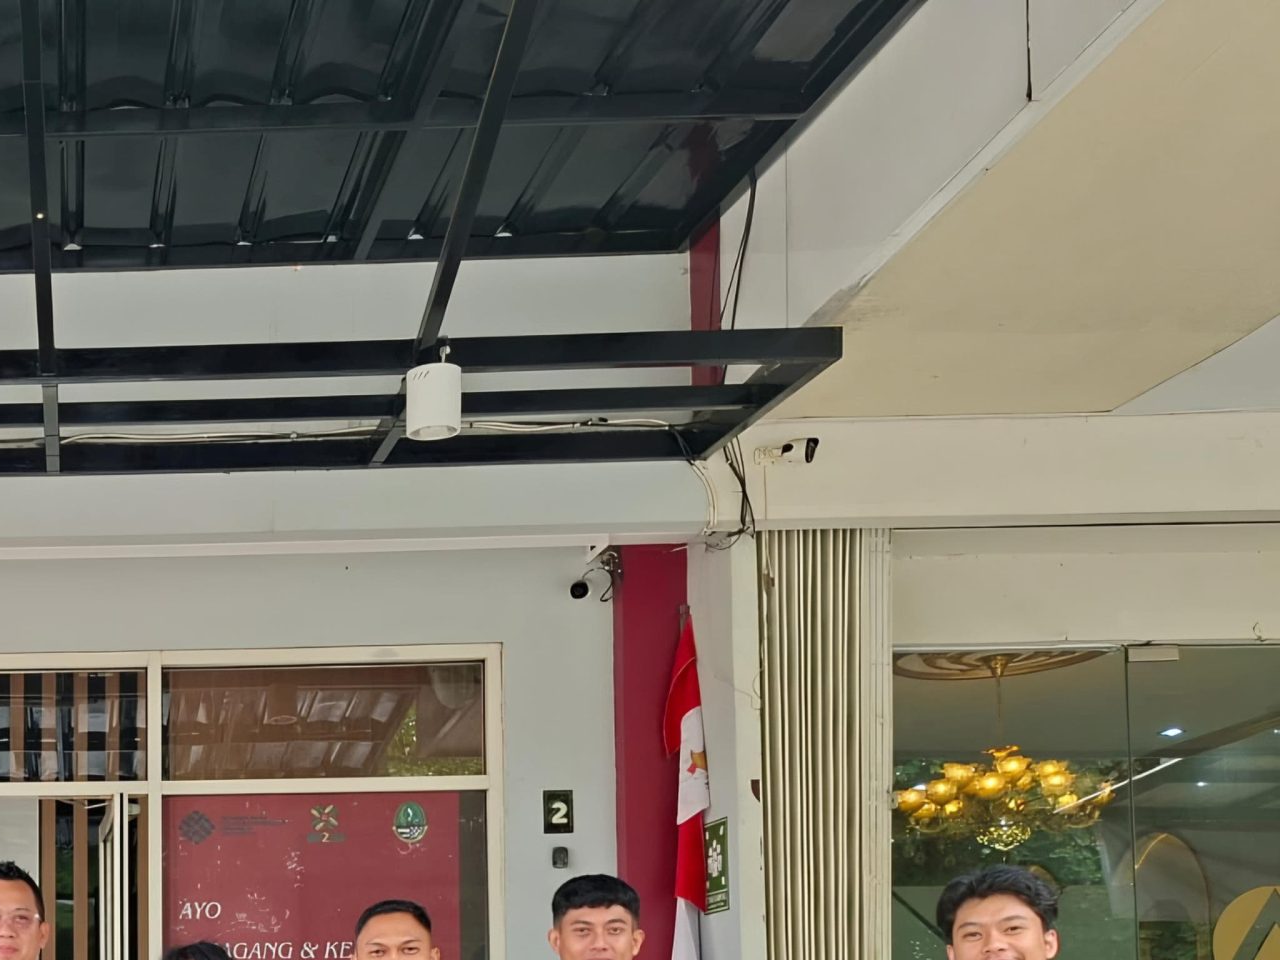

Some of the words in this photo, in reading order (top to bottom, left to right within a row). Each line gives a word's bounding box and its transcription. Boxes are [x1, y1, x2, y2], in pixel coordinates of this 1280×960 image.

[551, 801, 568, 824] 2
[179, 901, 222, 919] AYO
[300, 941, 319, 959] &
